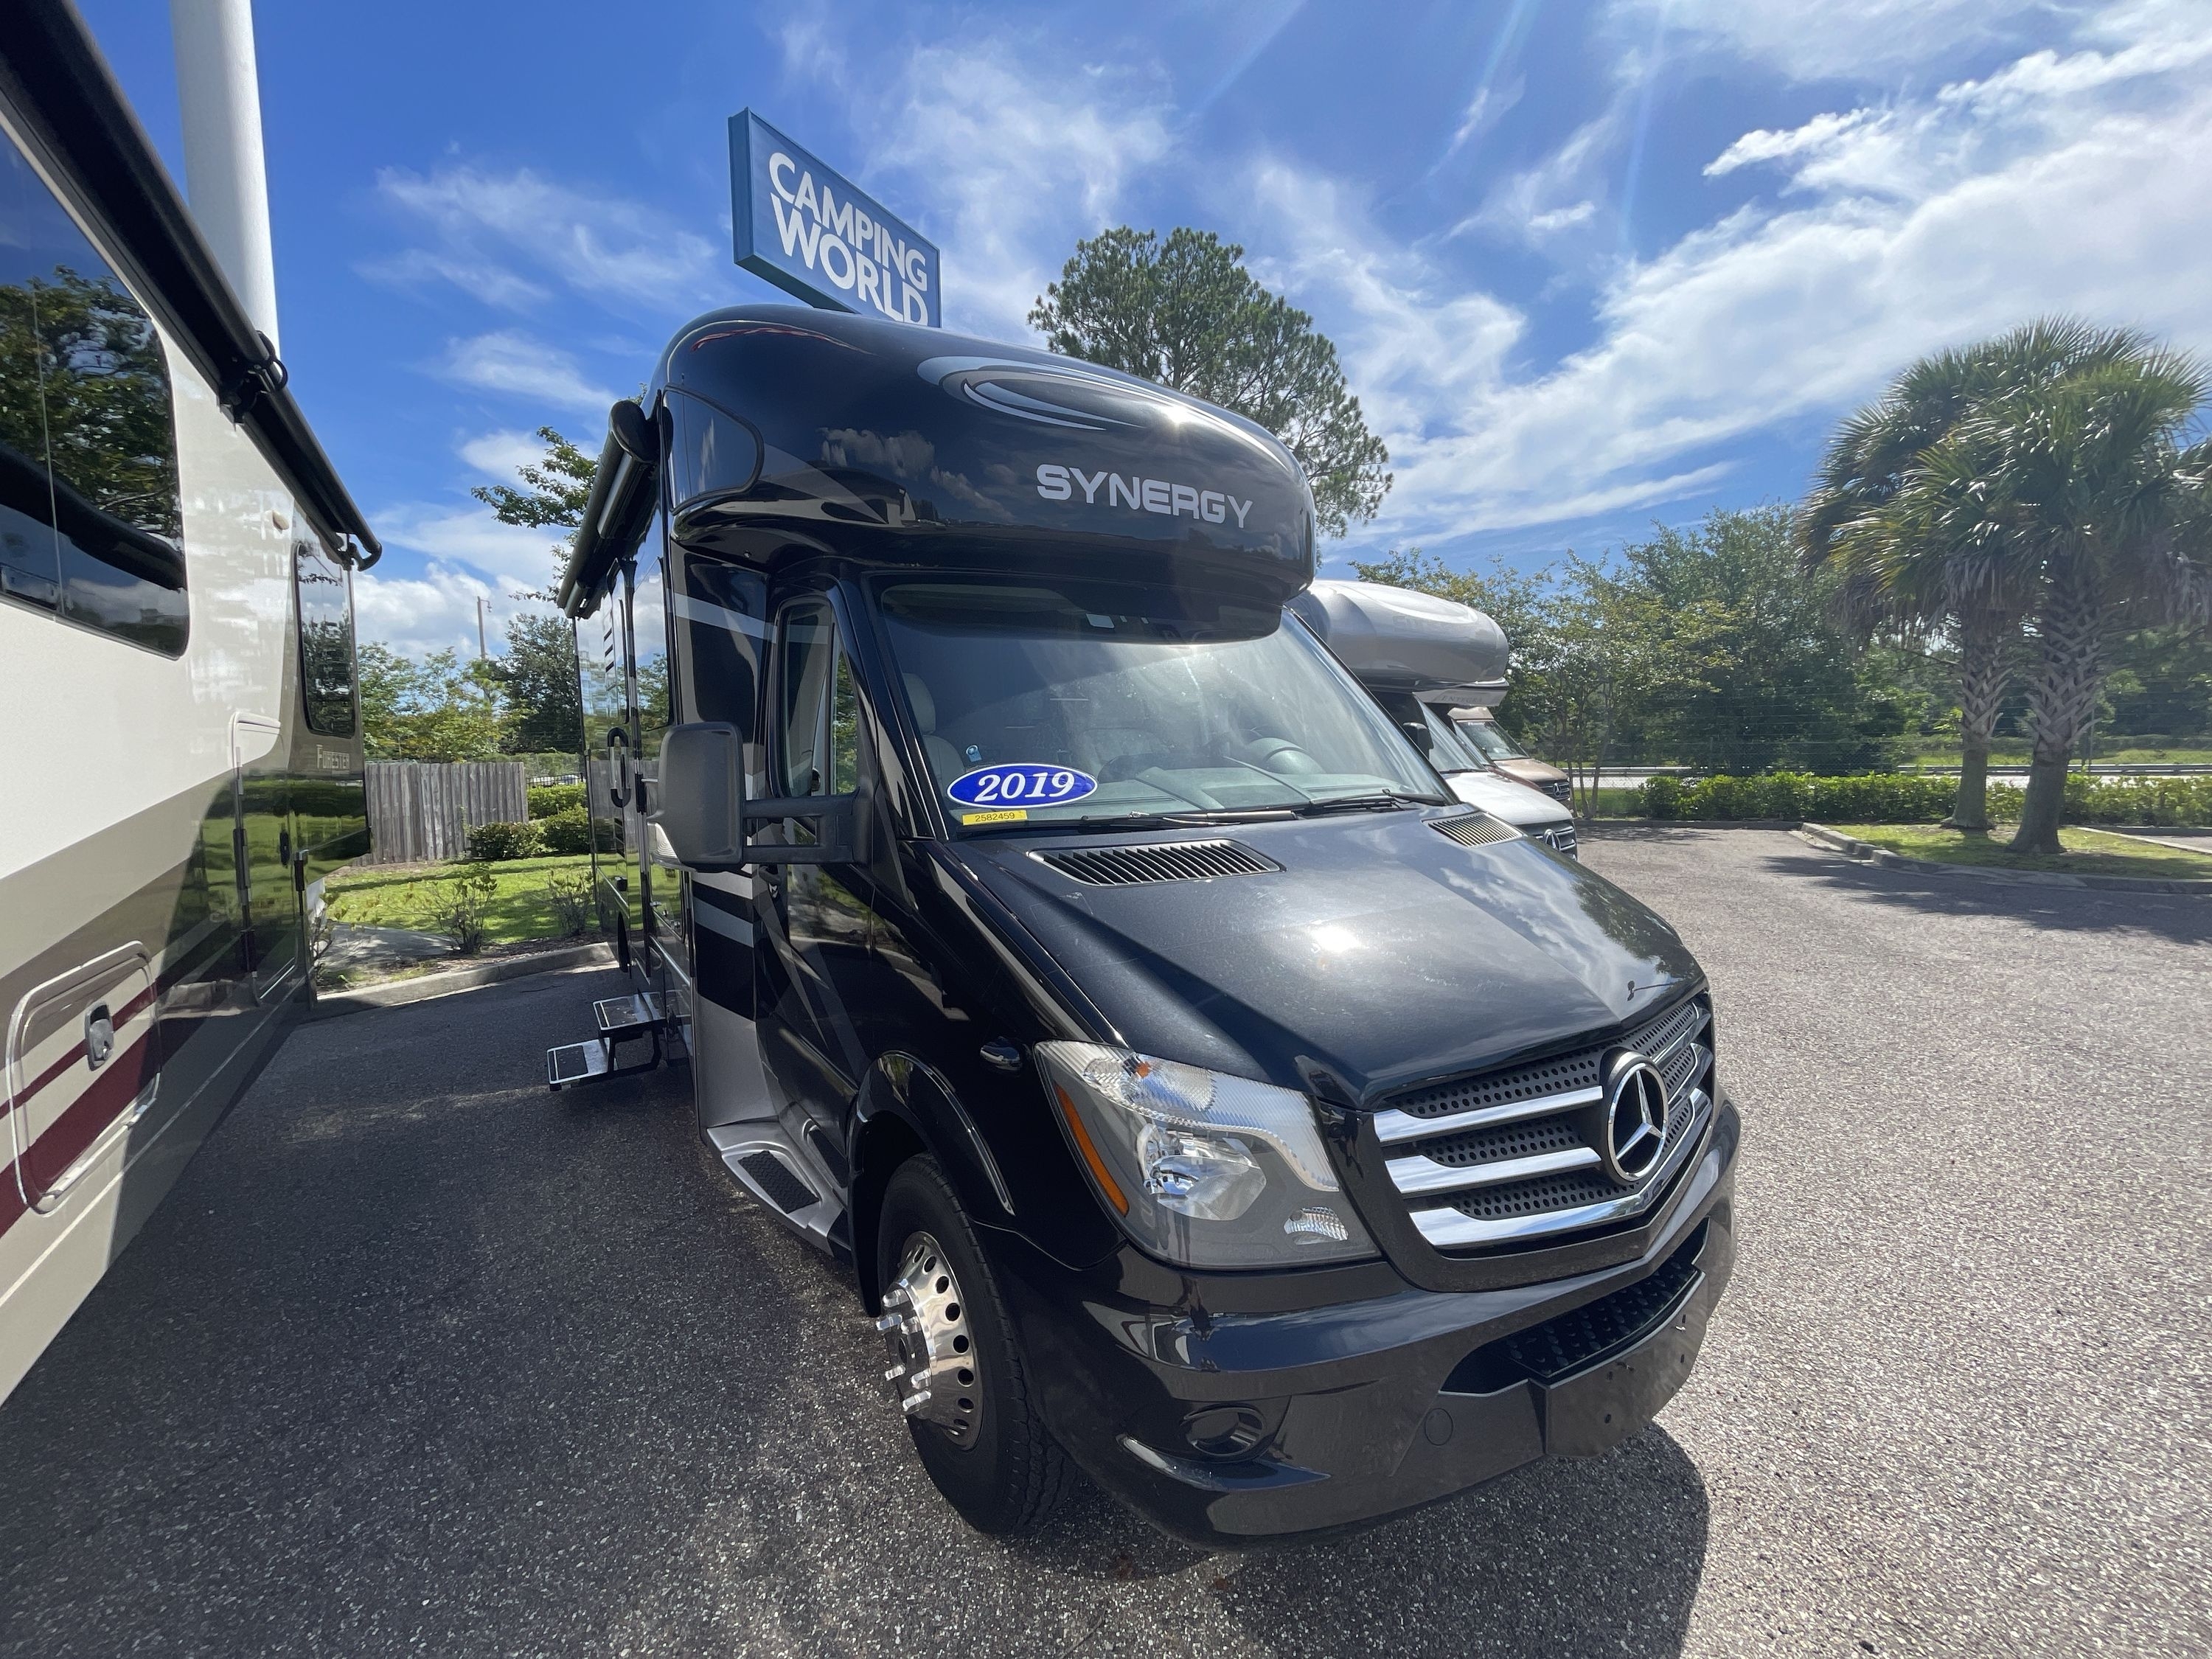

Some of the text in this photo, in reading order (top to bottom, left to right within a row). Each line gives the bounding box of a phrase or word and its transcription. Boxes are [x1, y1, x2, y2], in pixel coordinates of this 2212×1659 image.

[769, 152, 928, 291] CAMPING
[771, 192, 928, 326] WORLD
[1036, 464, 1253, 529] SYNERGY
[316, 744, 350, 769] FORESTER
[973, 771, 1075, 802] 2019
[975, 812, 1015, 822] 2582459
